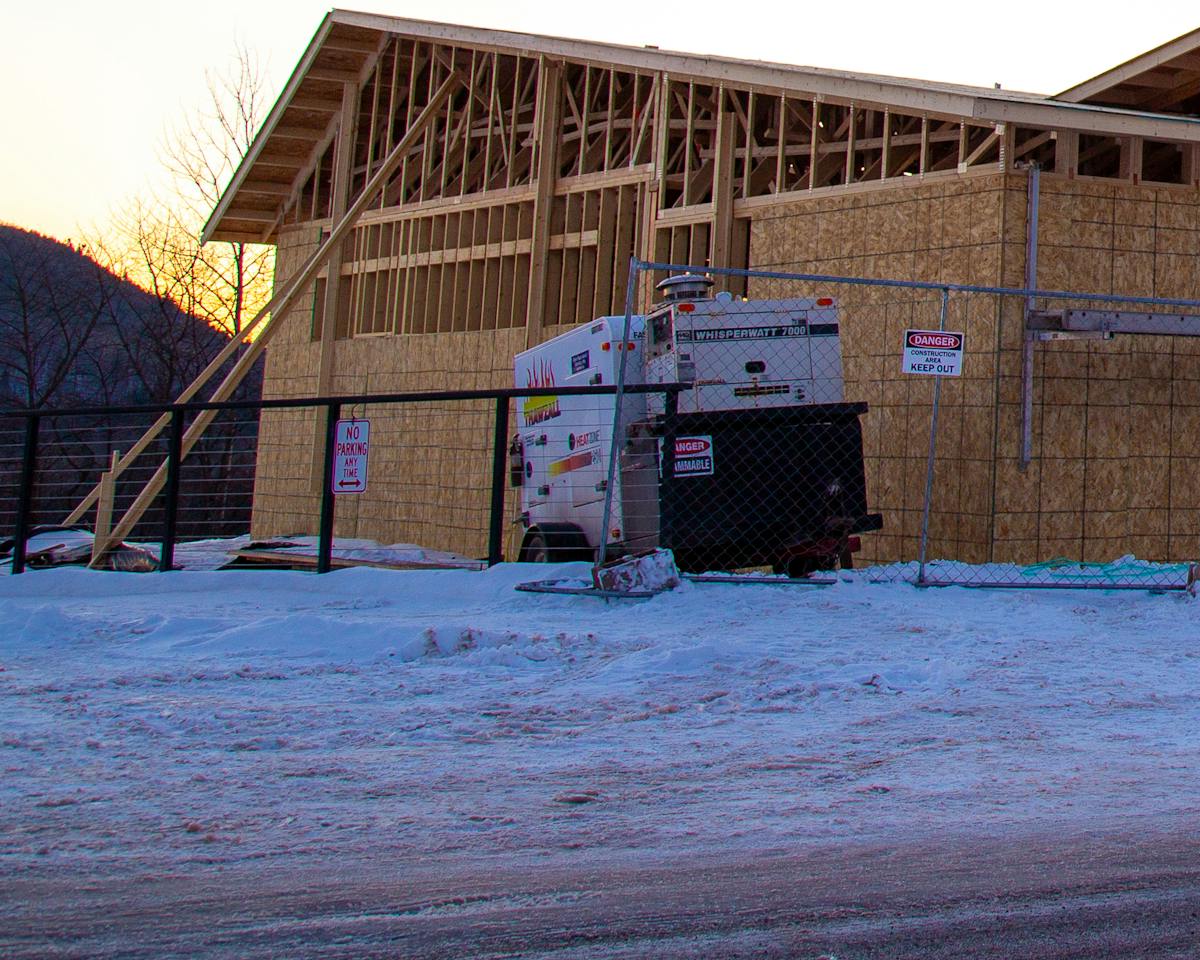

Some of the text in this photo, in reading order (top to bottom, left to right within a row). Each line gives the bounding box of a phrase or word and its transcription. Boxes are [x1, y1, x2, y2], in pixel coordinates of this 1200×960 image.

[695, 327, 777, 340] WHISPERWATT
[782, 326, 806, 336] 7000
[914, 335, 955, 346] DANGER
[911, 349, 956, 357] CONSTRUCTION
[911, 363, 955, 373] KEEP OUT
[346, 426, 360, 440] NO
[337, 442, 368, 456] PARKING
[675, 442, 706, 451] NGER
[345, 457, 358, 467] ANY
[674, 459, 711, 471] MMABLE
[343, 468, 358, 478] TIME
